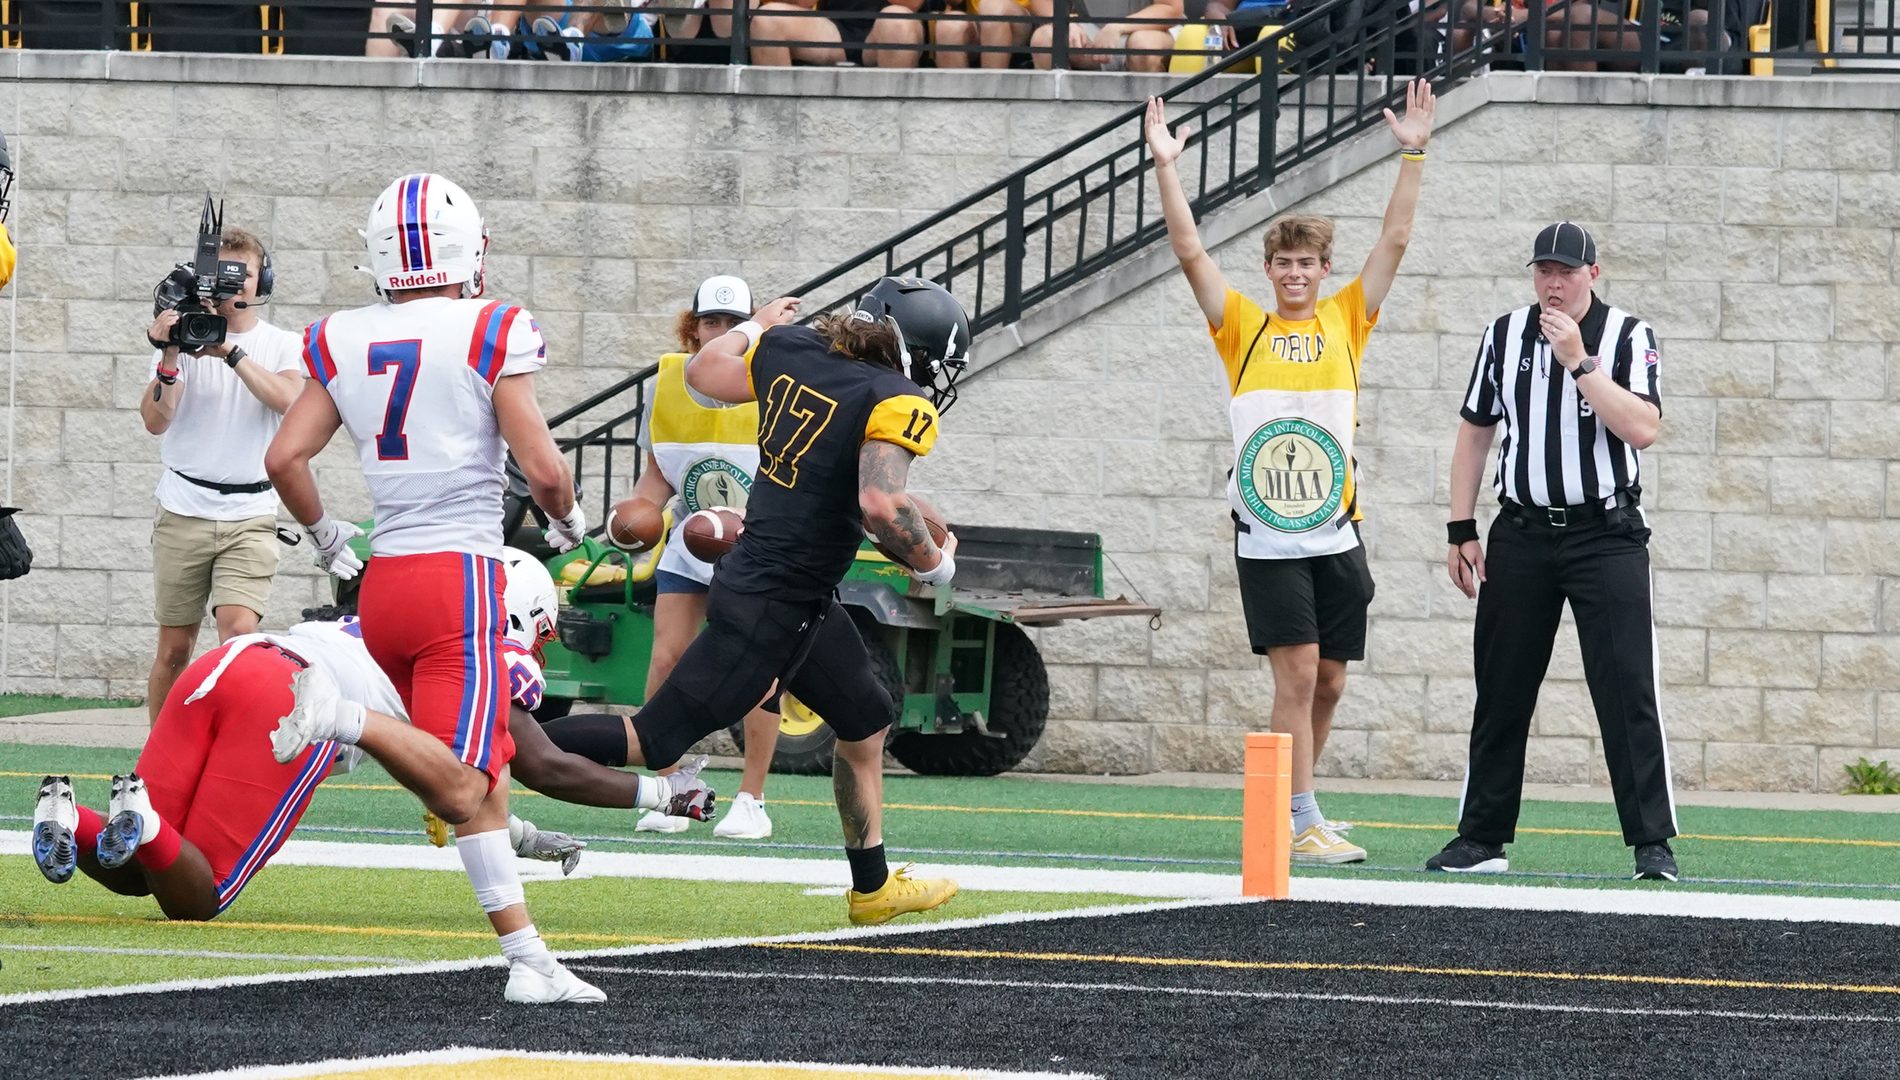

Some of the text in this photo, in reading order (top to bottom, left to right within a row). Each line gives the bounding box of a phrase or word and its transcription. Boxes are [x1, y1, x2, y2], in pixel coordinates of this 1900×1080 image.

[389, 272, 448, 288] Riddell
[367, 339, 423, 461] 7
[1580, 399, 1593, 417] S
[757, 373, 839, 489] 17
[902, 408, 933, 444] 17
[1242, 423, 1344, 480] MICHIGAN INTERCOLLEGIATE
[1262, 470, 1325, 500] MIAA
[1243, 483, 1343, 528] ATHLETIC ASSOCIATION
